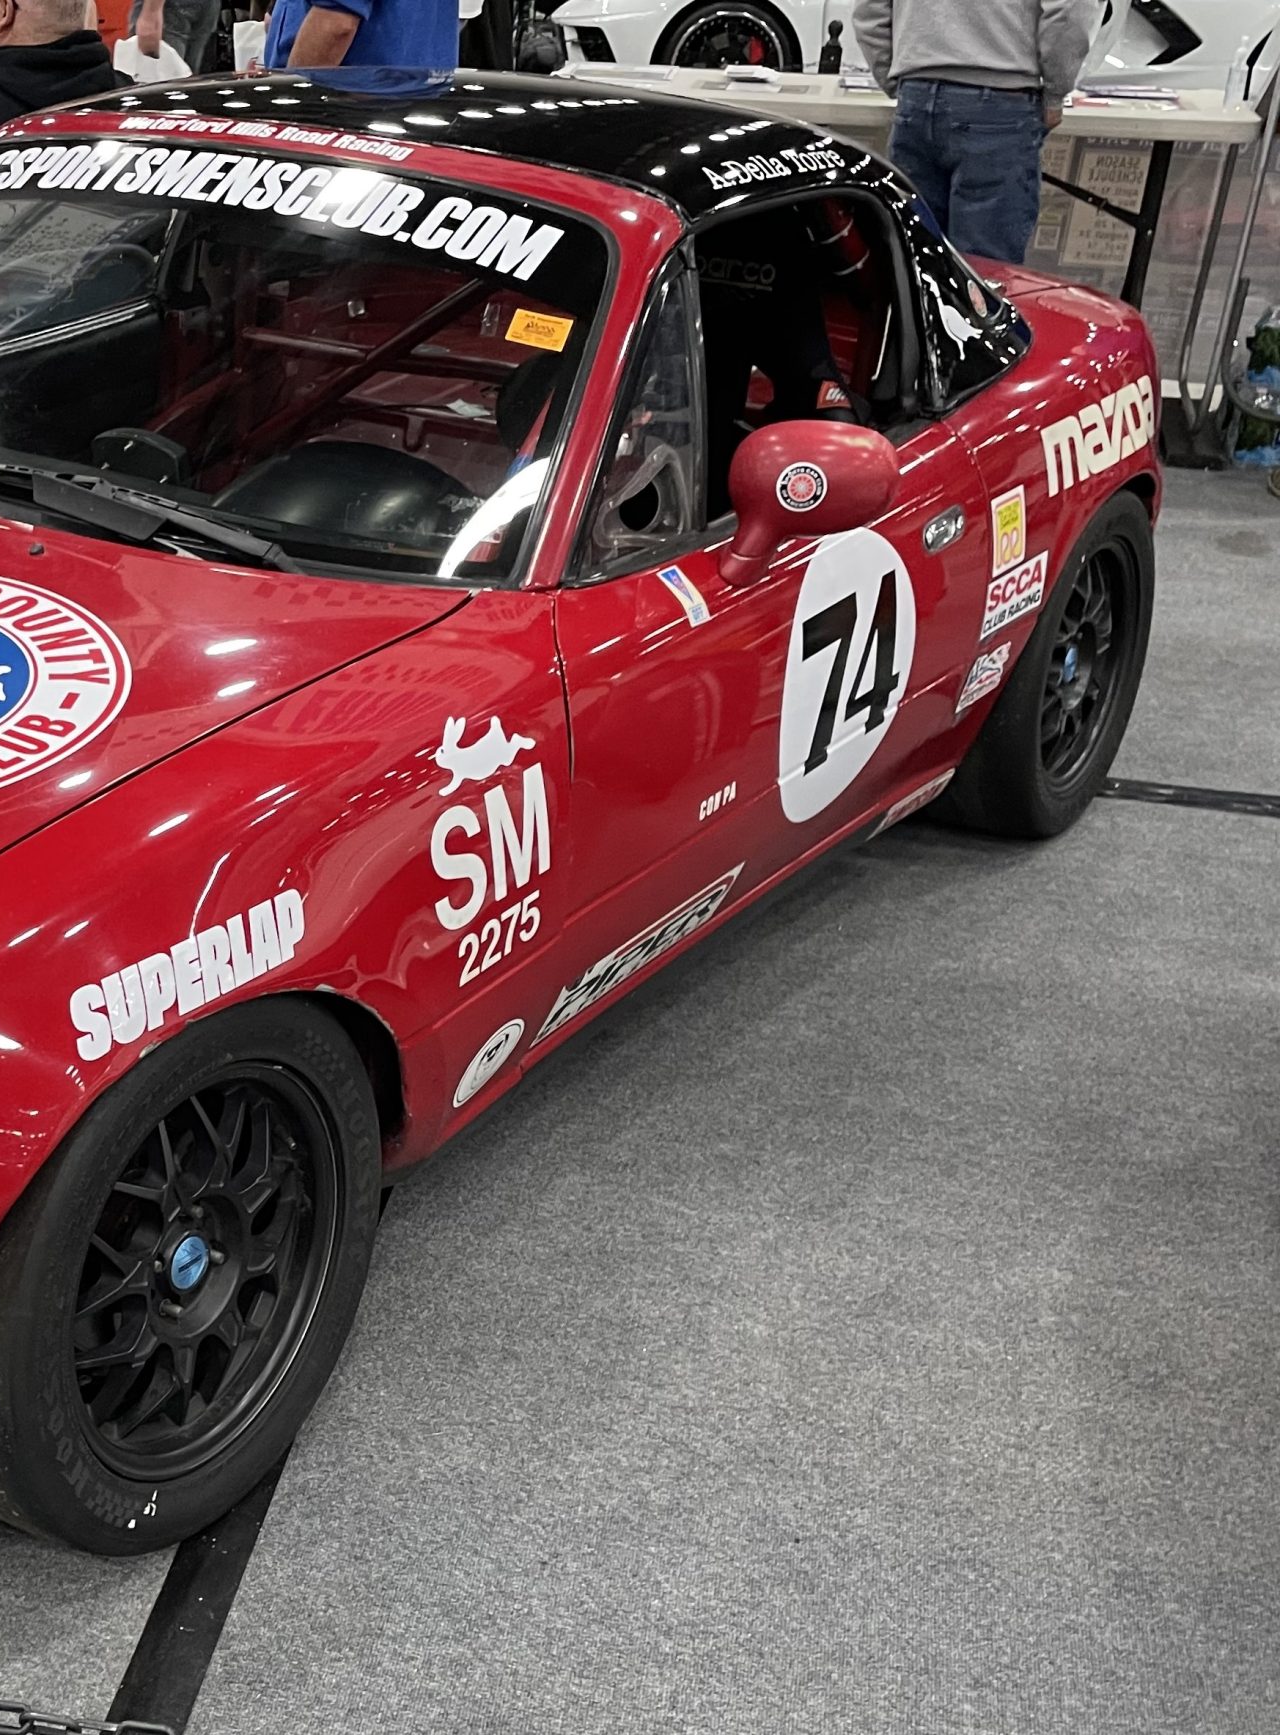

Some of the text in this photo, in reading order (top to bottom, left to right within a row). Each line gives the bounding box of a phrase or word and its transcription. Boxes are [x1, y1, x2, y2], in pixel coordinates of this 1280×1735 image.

[119, 115, 415, 162] Waterford Hills Road Racing
[779, 149, 846, 173] Torre
[983, 589, 1041, 634] CLUB RACING
[988, 559, 1043, 613] SCCA
[801, 569, 901, 777] 74
[430, 762, 551, 931] SM
[69, 888, 305, 1061] SUPERLAP
[458, 890, 542, 987] 2275
